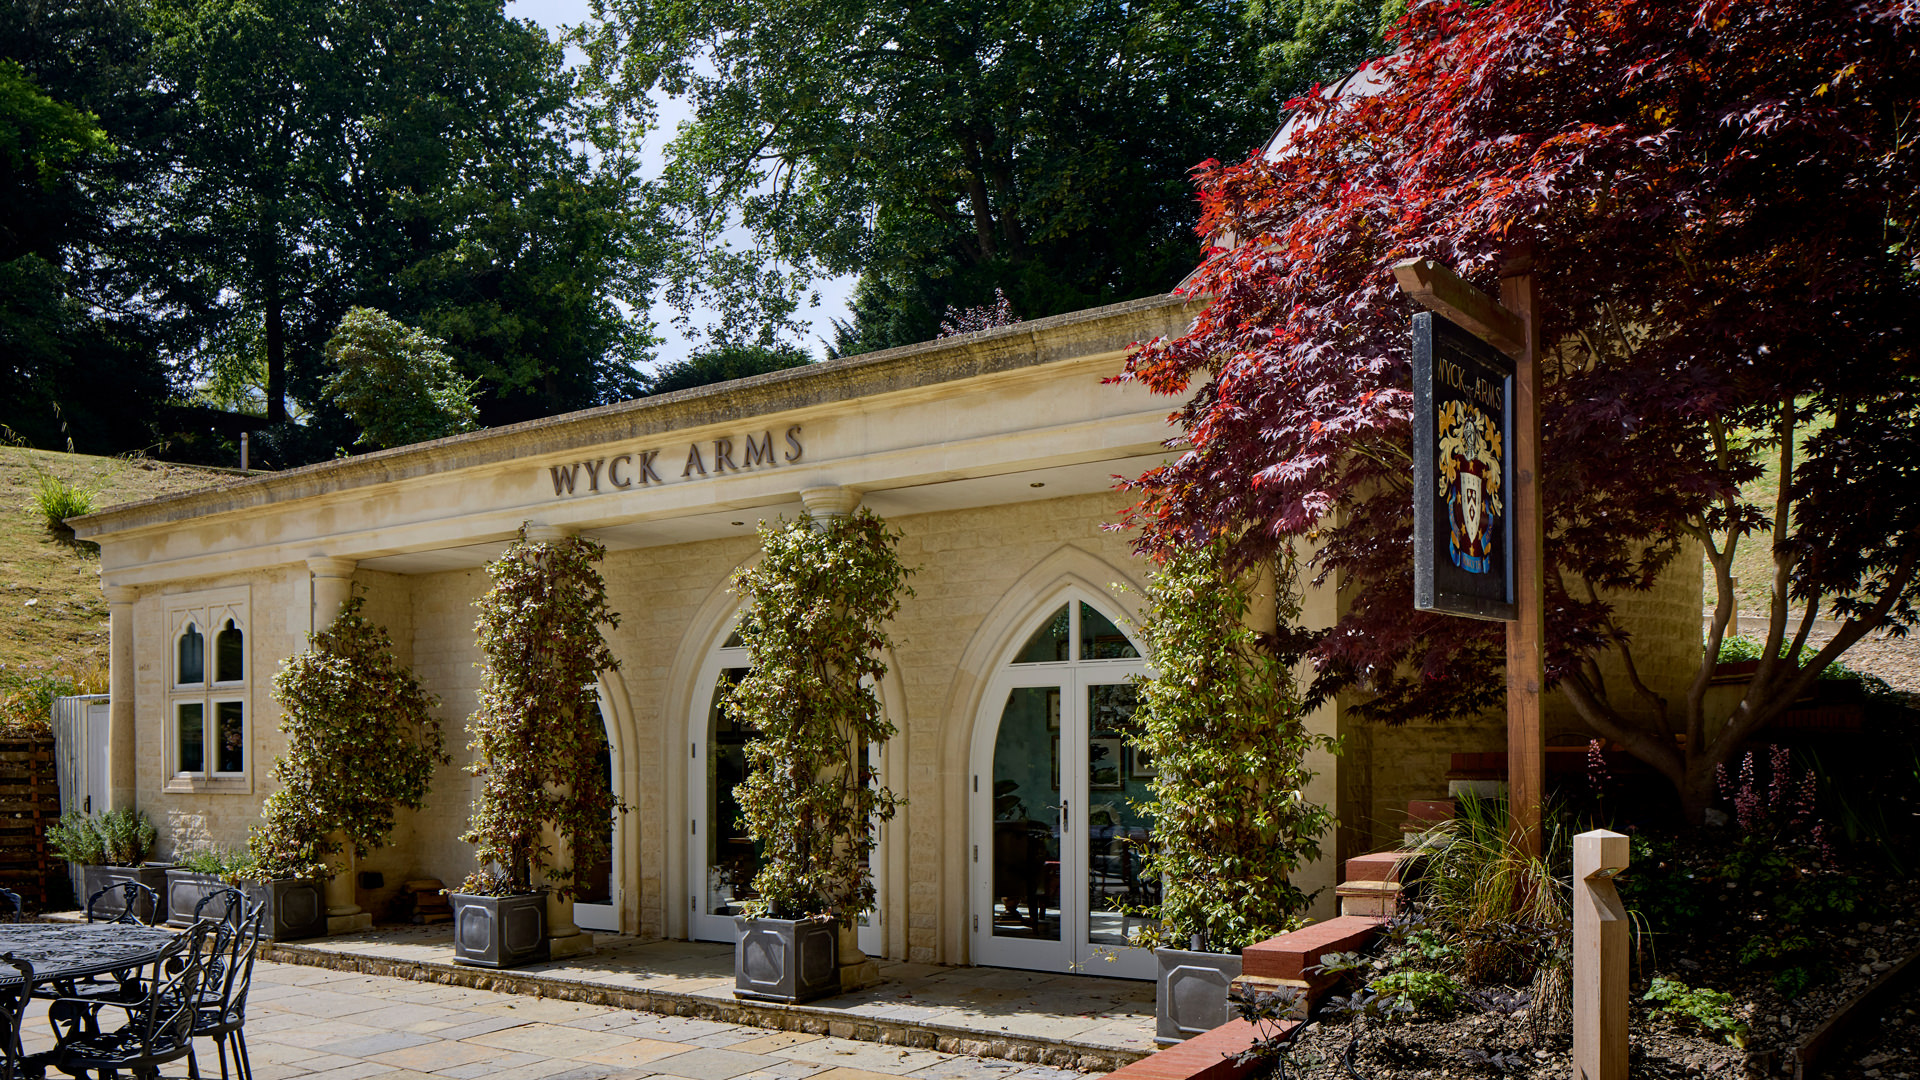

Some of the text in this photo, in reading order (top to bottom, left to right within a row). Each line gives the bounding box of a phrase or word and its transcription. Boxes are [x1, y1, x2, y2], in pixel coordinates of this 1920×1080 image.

[1474, 376, 1502, 411] ARMS
[549, 423, 803, 496] WYCK ARMS
